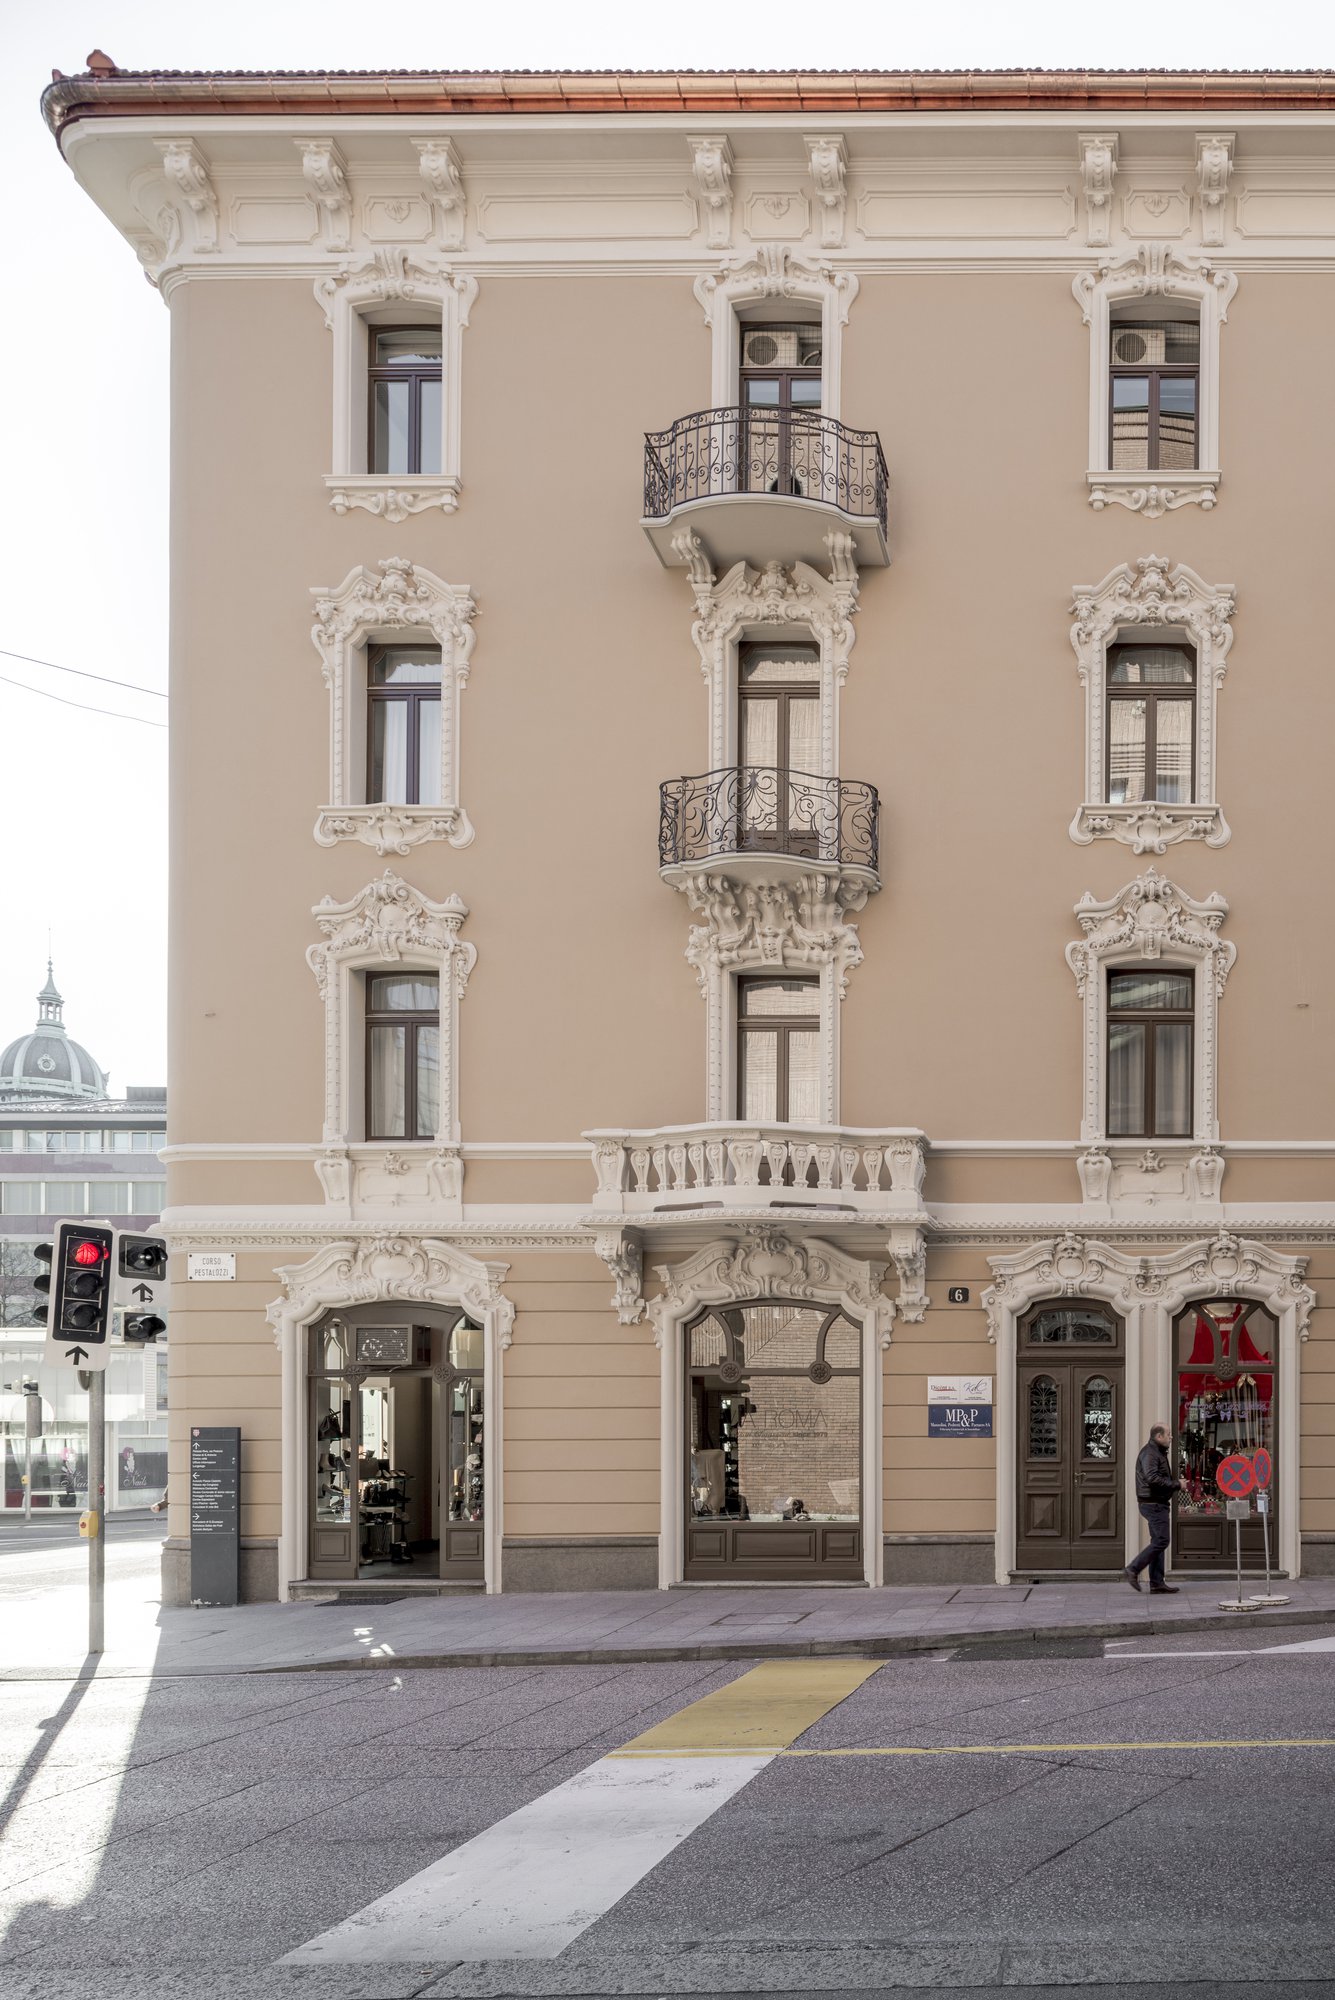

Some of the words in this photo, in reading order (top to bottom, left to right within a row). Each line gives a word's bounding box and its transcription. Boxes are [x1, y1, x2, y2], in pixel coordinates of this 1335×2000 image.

[202, 1257, 221, 1265] CORSO
[194, 1268, 229, 1277] PESTALOZZI
[955, 1289, 963, 1301] 6
[765, 1409, 828, 1428] ROMA
[945, 1408, 979, 1427] MP&P
